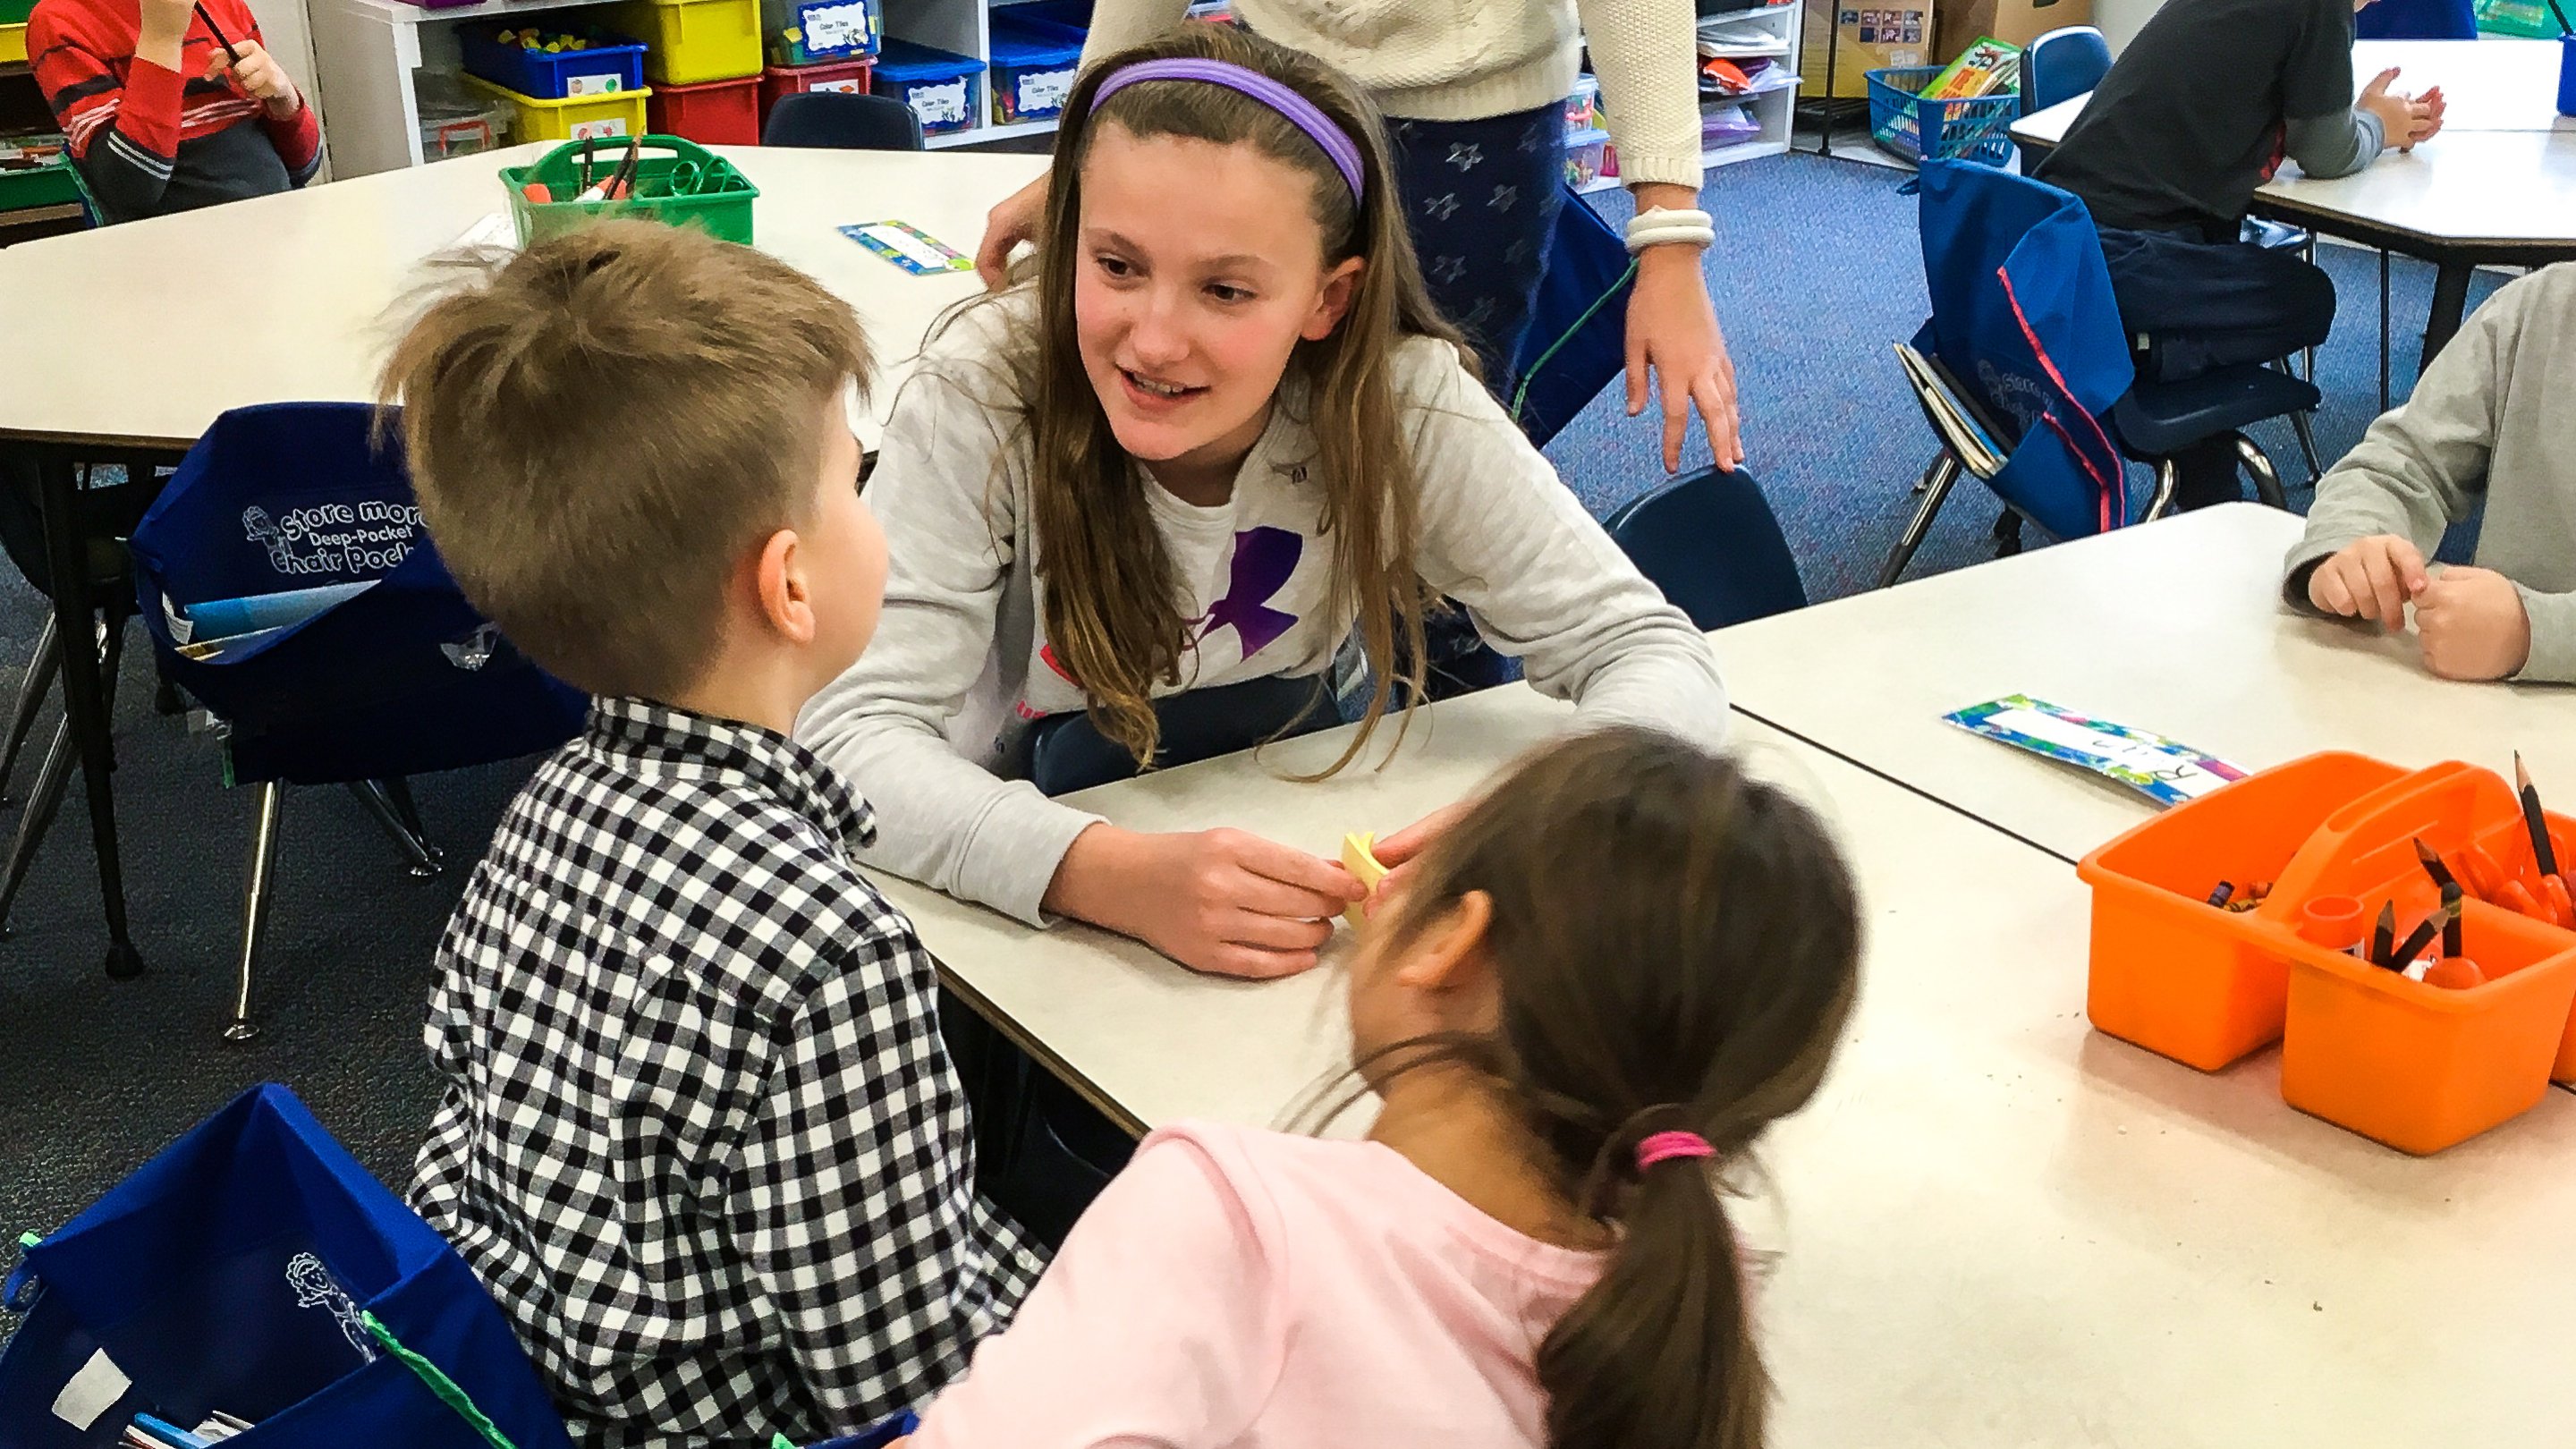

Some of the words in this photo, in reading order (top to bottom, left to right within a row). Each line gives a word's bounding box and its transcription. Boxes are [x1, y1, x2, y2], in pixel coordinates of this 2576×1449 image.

[280, 504, 354, 541] Store
[359, 501, 429, 528] mor
[309, 524, 413, 547] Deep-Pocket
[270, 547, 343, 574] Chair
